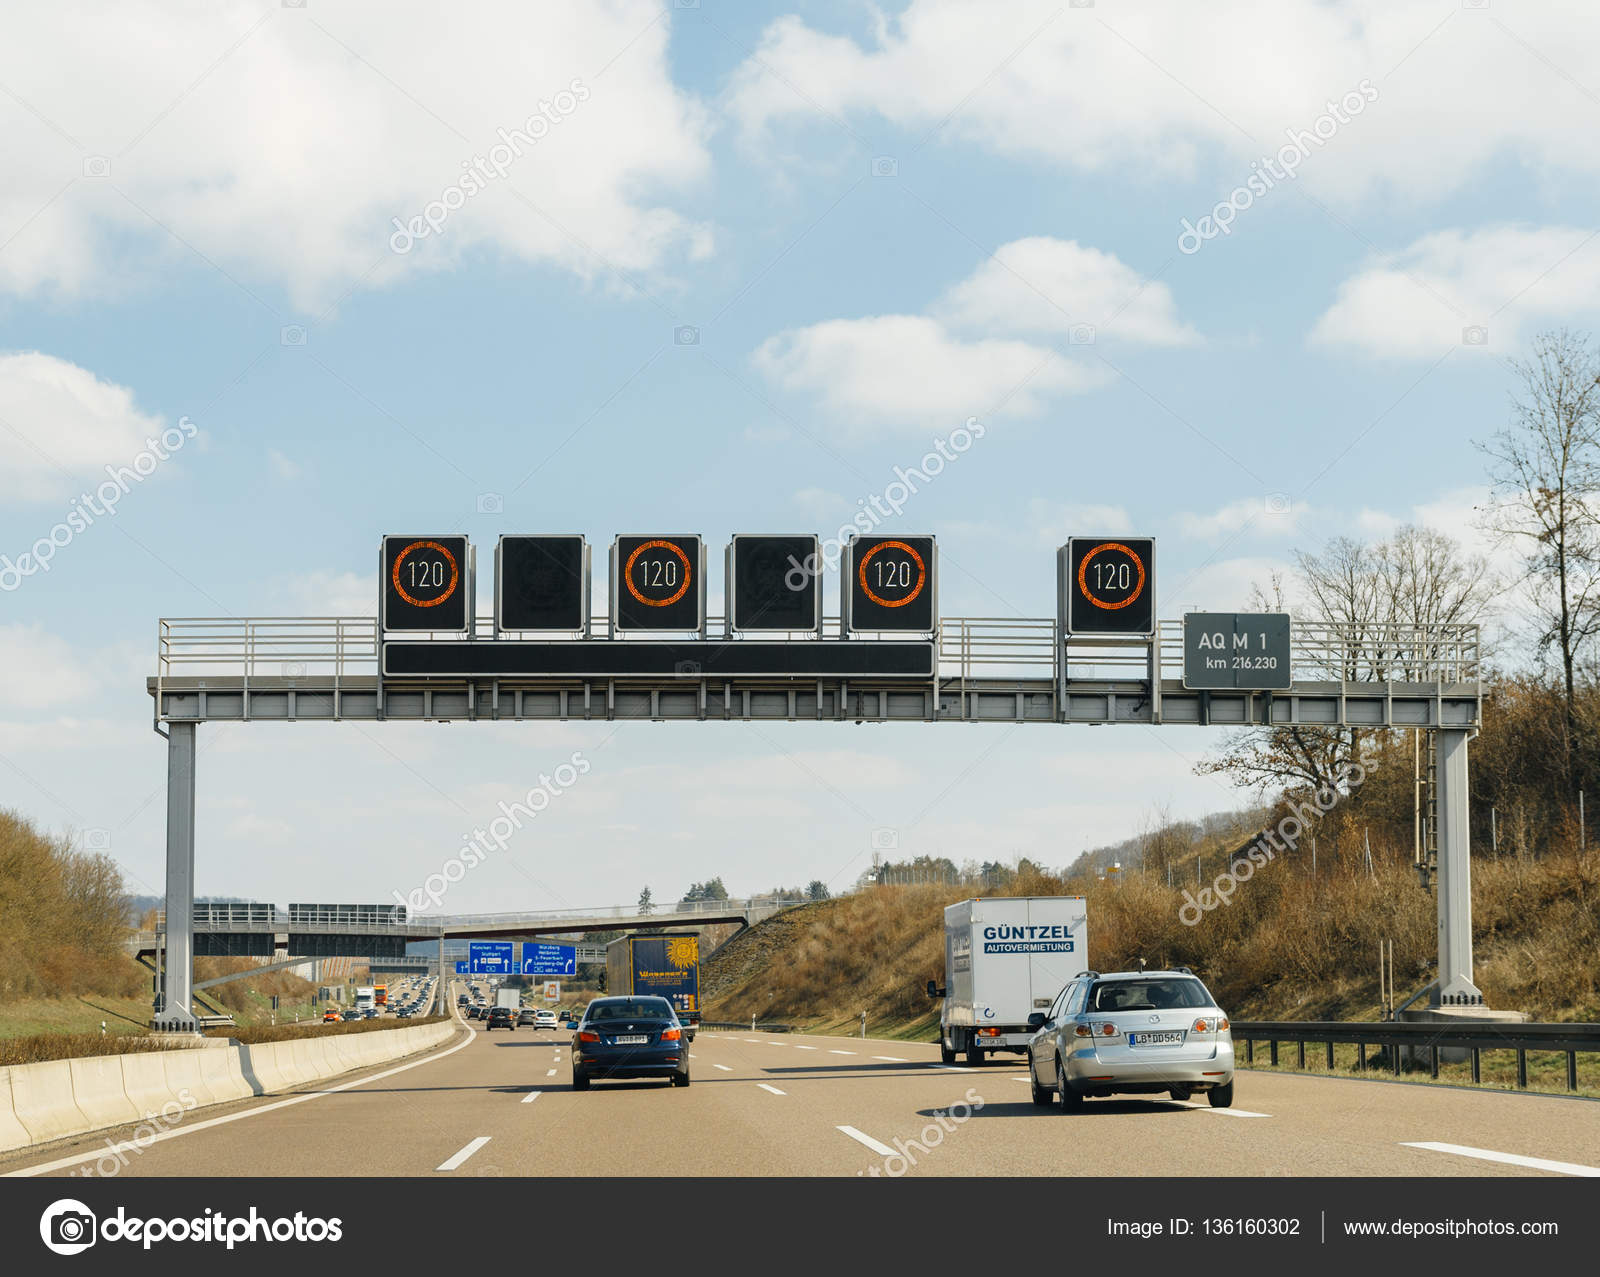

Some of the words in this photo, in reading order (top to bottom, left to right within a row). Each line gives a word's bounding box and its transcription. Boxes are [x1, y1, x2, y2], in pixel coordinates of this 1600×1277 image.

[407, 561, 443, 587] 120
[640, 561, 676, 587] 120
[874, 561, 911, 587] 120
[1093, 563, 1130, 590] 120
[1198, 632, 1226, 650] AQ
[1232, 632, 1248, 650] M
[1259, 632, 1266, 650] 1
[1206, 656, 1227, 669] km
[1231, 656, 1278, 669] 216.230
[983, 923, 1074, 940] GÜNTZEL
[986, 942, 1071, 952] AUTOVERMIETUNG
